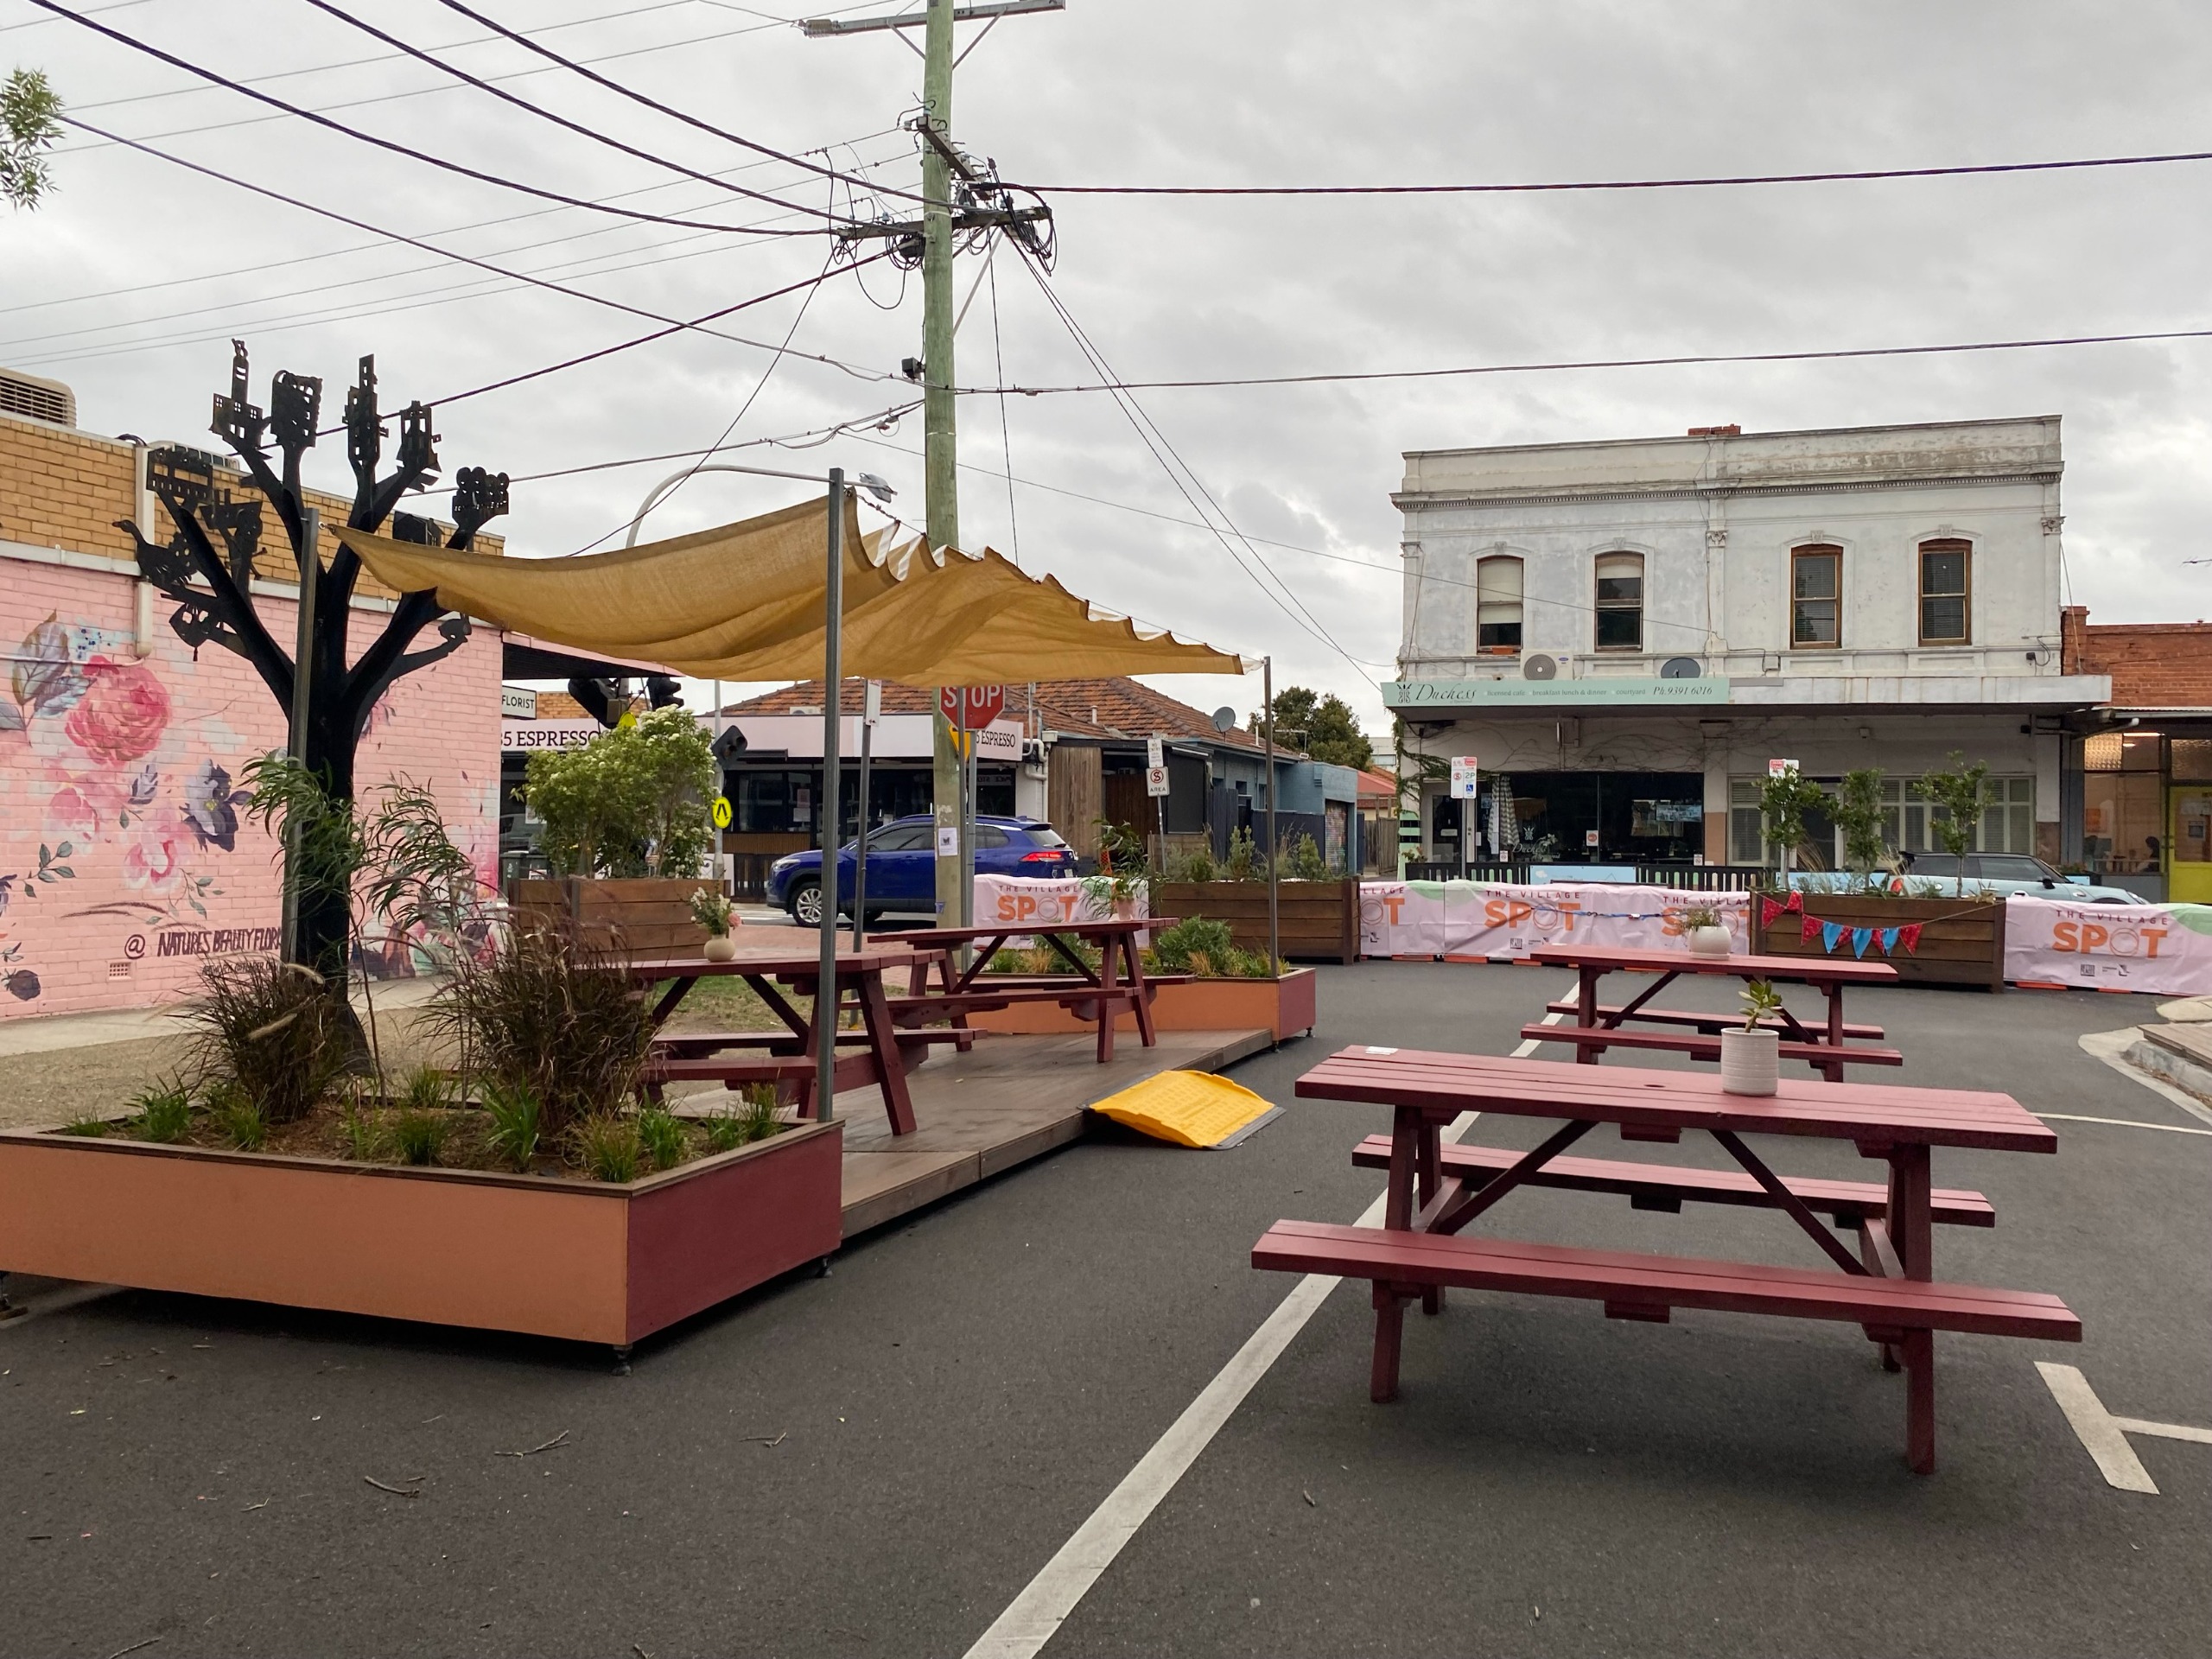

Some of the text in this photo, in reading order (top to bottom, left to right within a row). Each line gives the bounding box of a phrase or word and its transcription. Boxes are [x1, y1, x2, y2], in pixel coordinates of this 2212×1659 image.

[1415, 683, 1477, 702] Duchess
[1690, 686, 1713, 696] 6016
[502, 695, 534, 709] FLORIST
[981, 730, 1015, 747] ESPRESSO
[1363, 887, 1404, 895] LLAGE
[997, 895, 1078, 923] SPOT
[1360, 898, 1405, 927] OT
[1484, 900, 1580, 931] SPOT
[2056, 910, 2168, 925] THE VILLAGE
[124, 934, 145, 959] @
[157, 931, 212, 957] NATURES
[2052, 922, 2168, 958] SPOT
